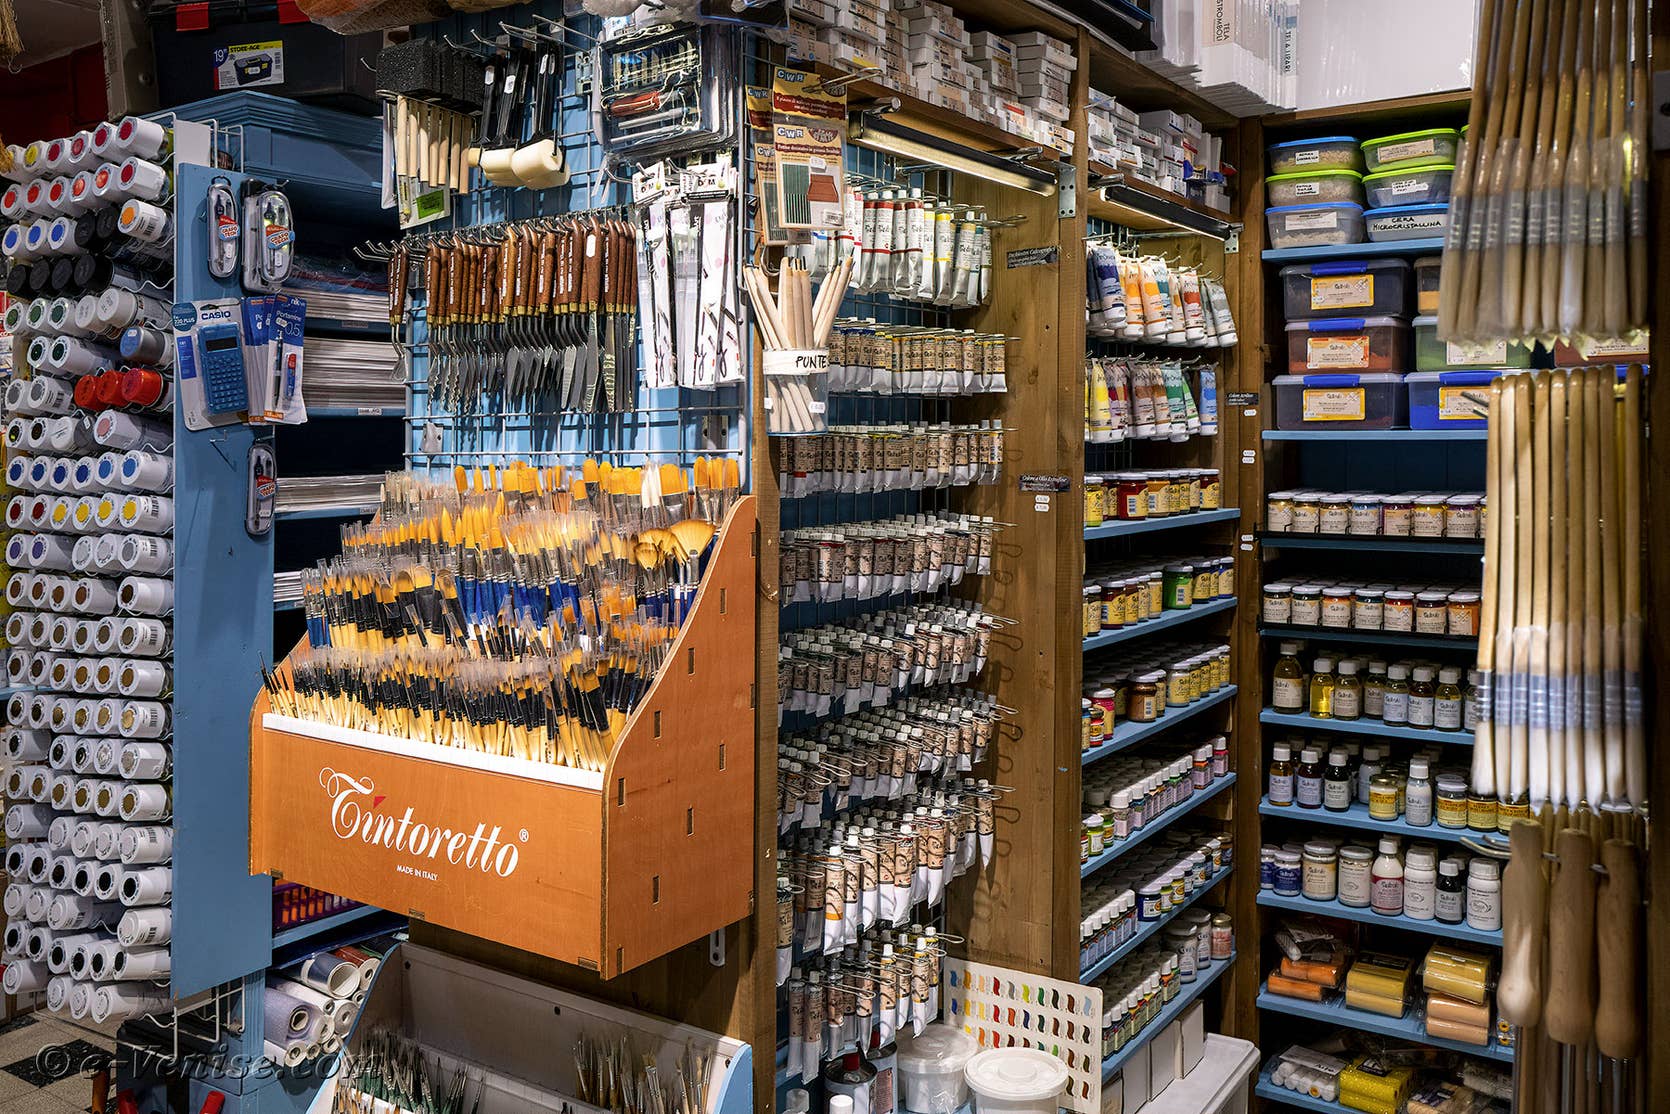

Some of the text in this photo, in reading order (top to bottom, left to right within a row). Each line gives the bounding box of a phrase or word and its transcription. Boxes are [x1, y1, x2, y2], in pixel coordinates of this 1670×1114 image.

[777, 69, 805, 82] CWR
[777, 126, 804, 139] CWR
[201, 310, 231, 320] CASIO
[795, 354, 827, 368] PUNTE
[319, 767, 519, 878] Tintoretto
[396, 864, 438, 881] MADE IN ITALY
